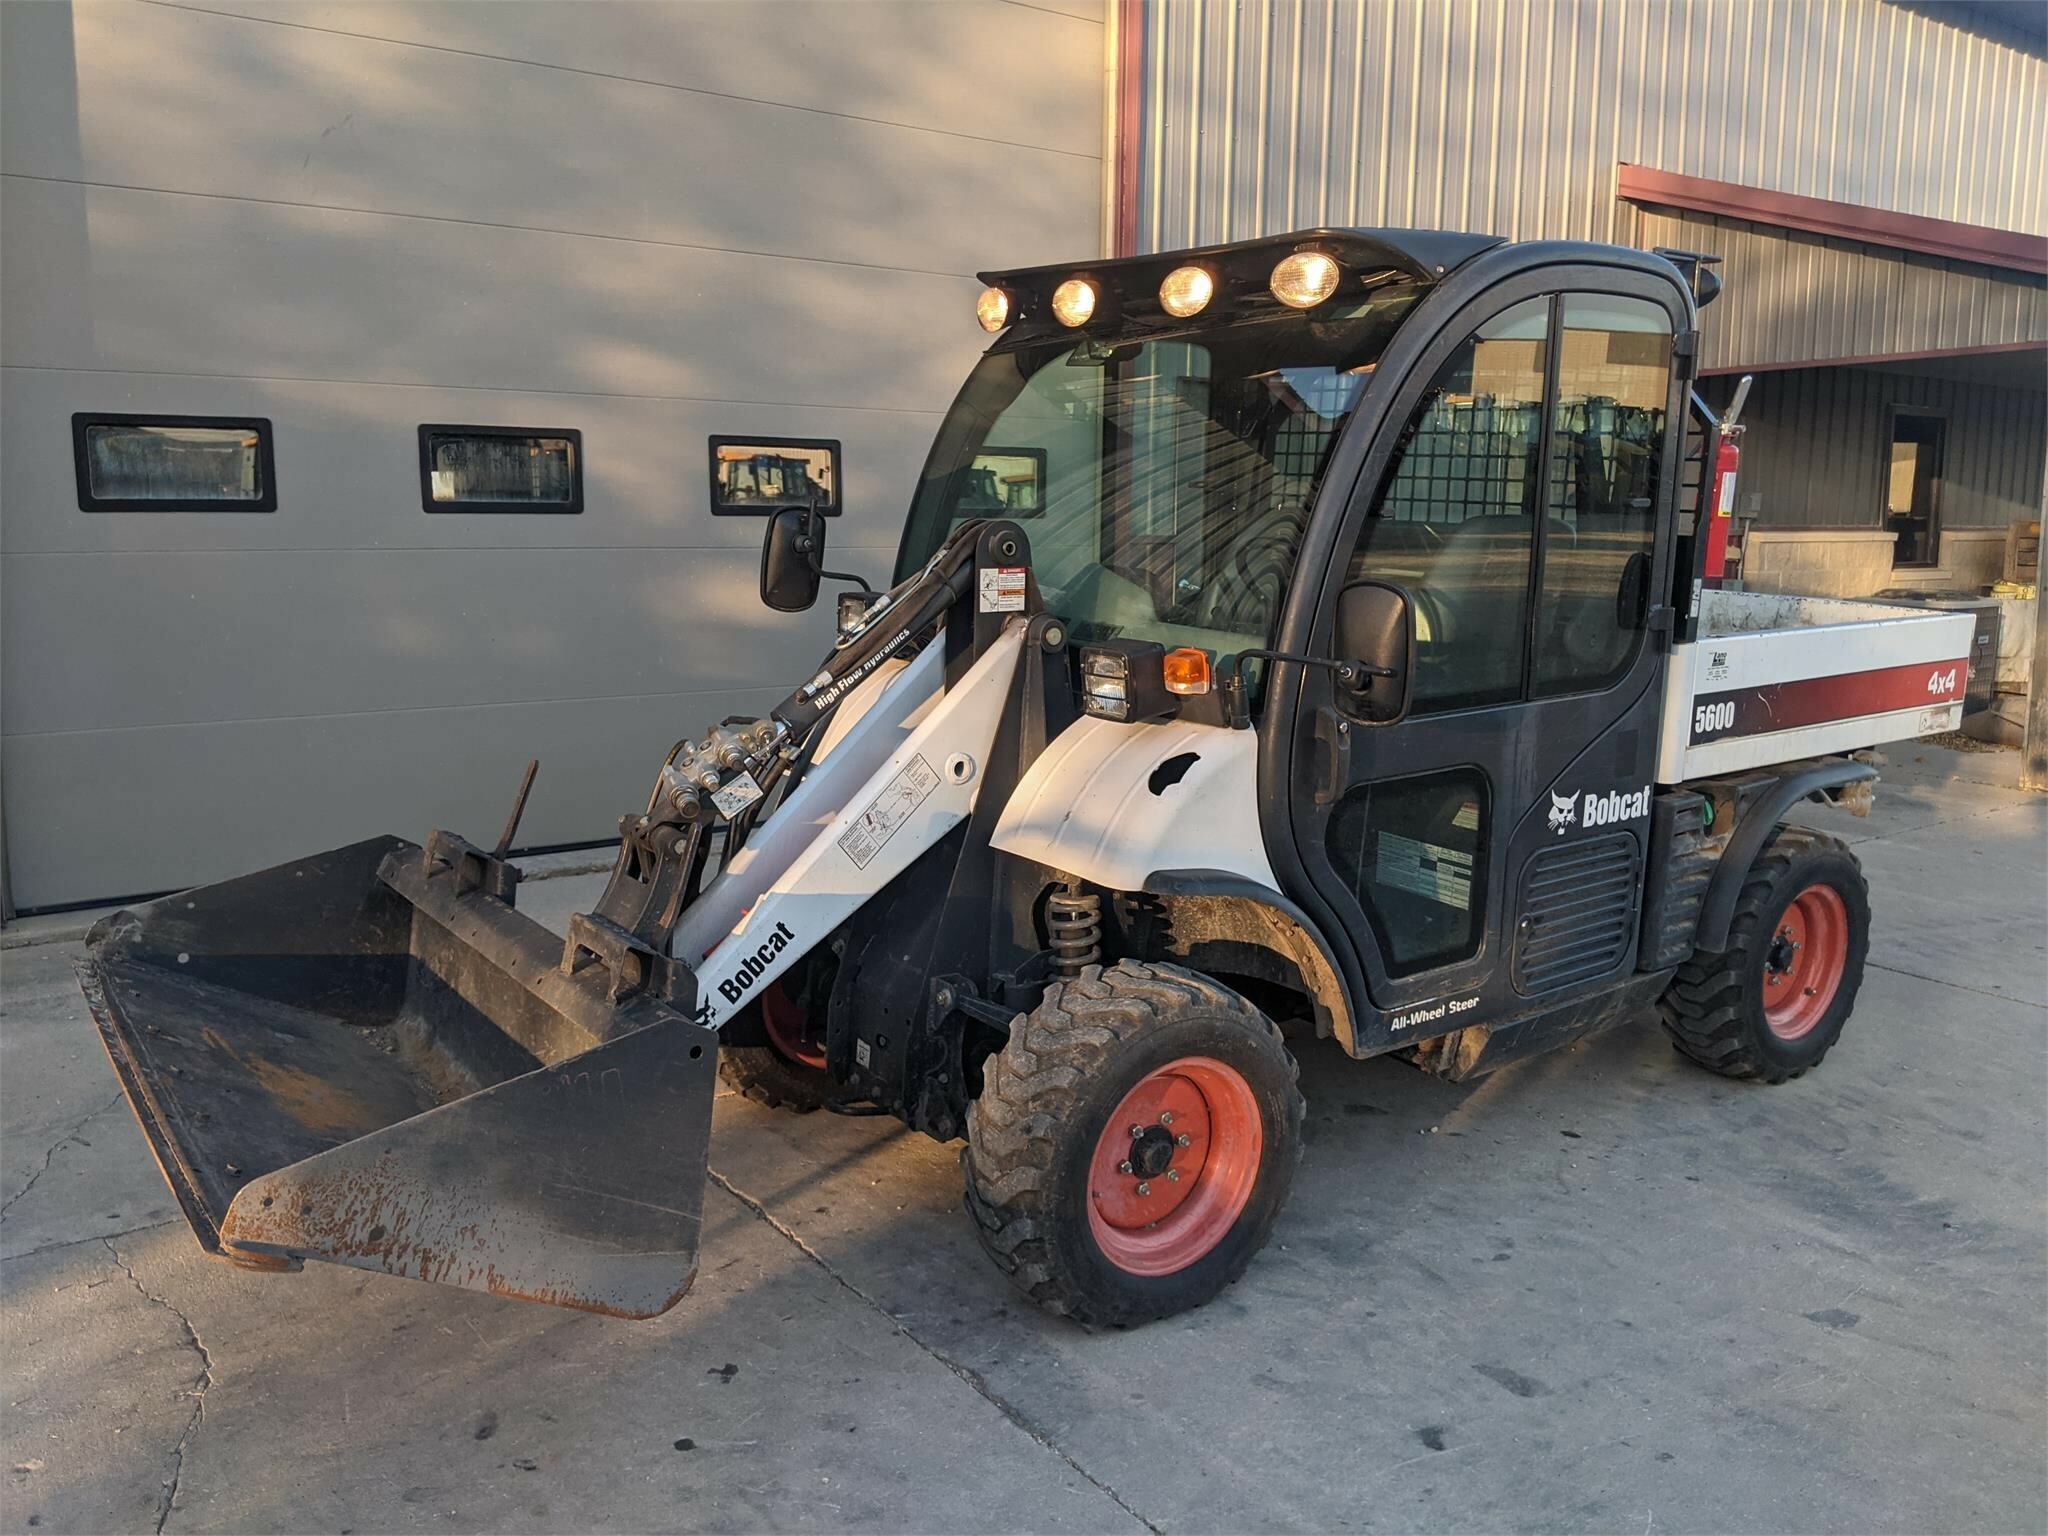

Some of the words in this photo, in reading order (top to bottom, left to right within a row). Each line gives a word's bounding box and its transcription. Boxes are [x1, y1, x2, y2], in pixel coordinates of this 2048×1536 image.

[814, 686, 840, 710] High
[837, 668, 863, 692] Flow
[1927, 668, 1956, 695] 4x4
[1694, 701, 1735, 734] 5600
[1582, 785, 1651, 828] Bobcat
[717, 921, 795, 1005] Bobcat
[1390, 1004, 1445, 1032] All-Wheel
[1448, 996, 1480, 1014] Steer
